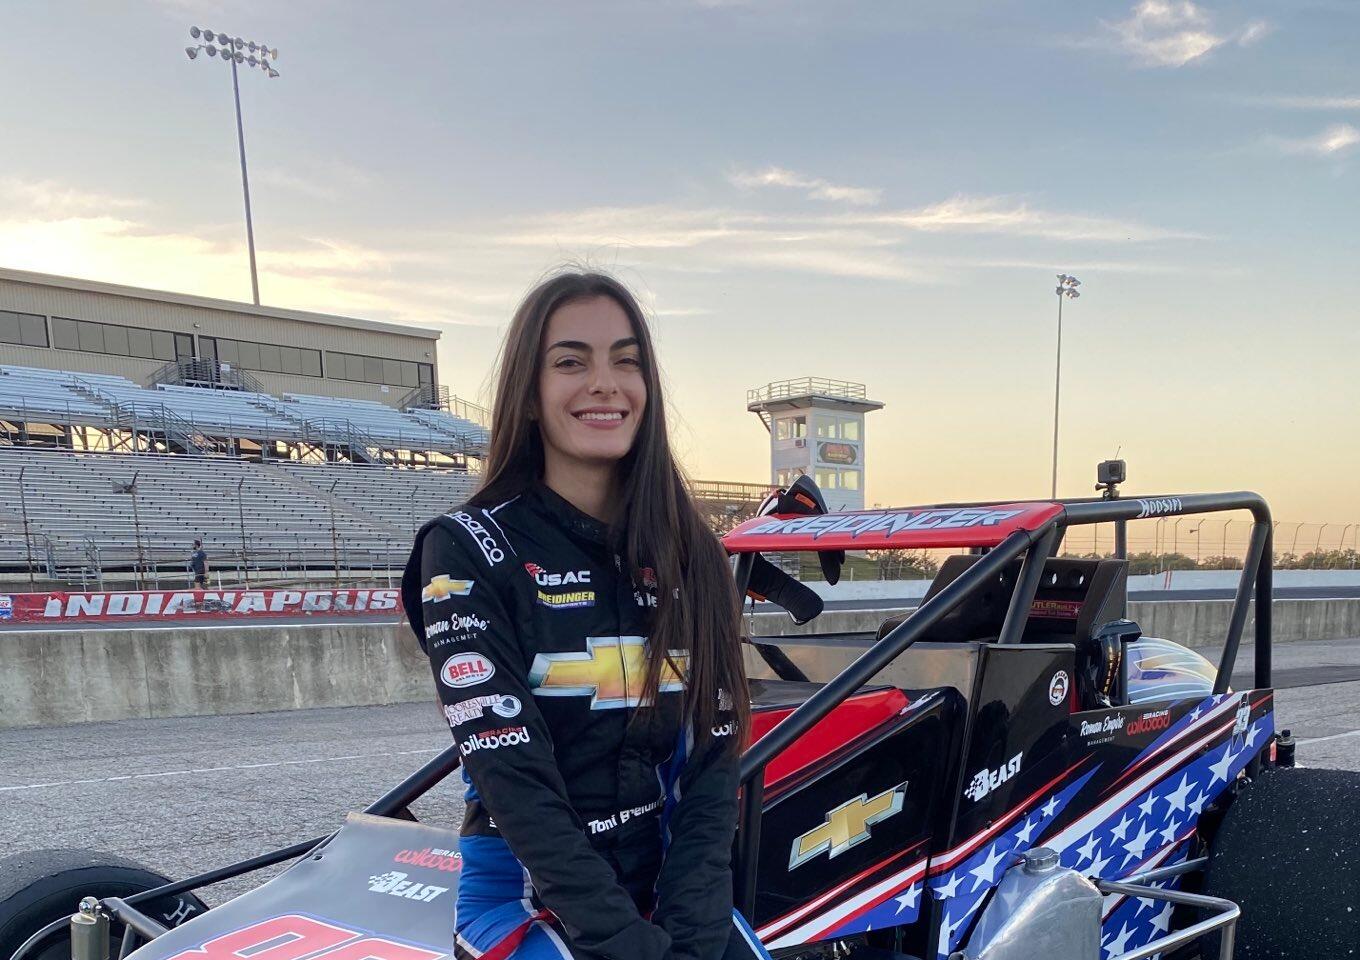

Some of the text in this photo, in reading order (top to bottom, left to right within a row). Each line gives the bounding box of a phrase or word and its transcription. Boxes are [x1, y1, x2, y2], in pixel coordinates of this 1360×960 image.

[742, 508, 1025, 539] BREIDINGER
[535, 570, 591, 586] USAC
[43, 590, 398, 617] INDIANAPOLIS
[448, 659, 488, 679] BELL
[449, 706, 484, 722] REALTY
[972, 751, 1023, 802] BEAST
[588, 814, 618, 835] Toni
[394, 847, 463, 872] wilwoo
[368, 871, 449, 903] BEAST
